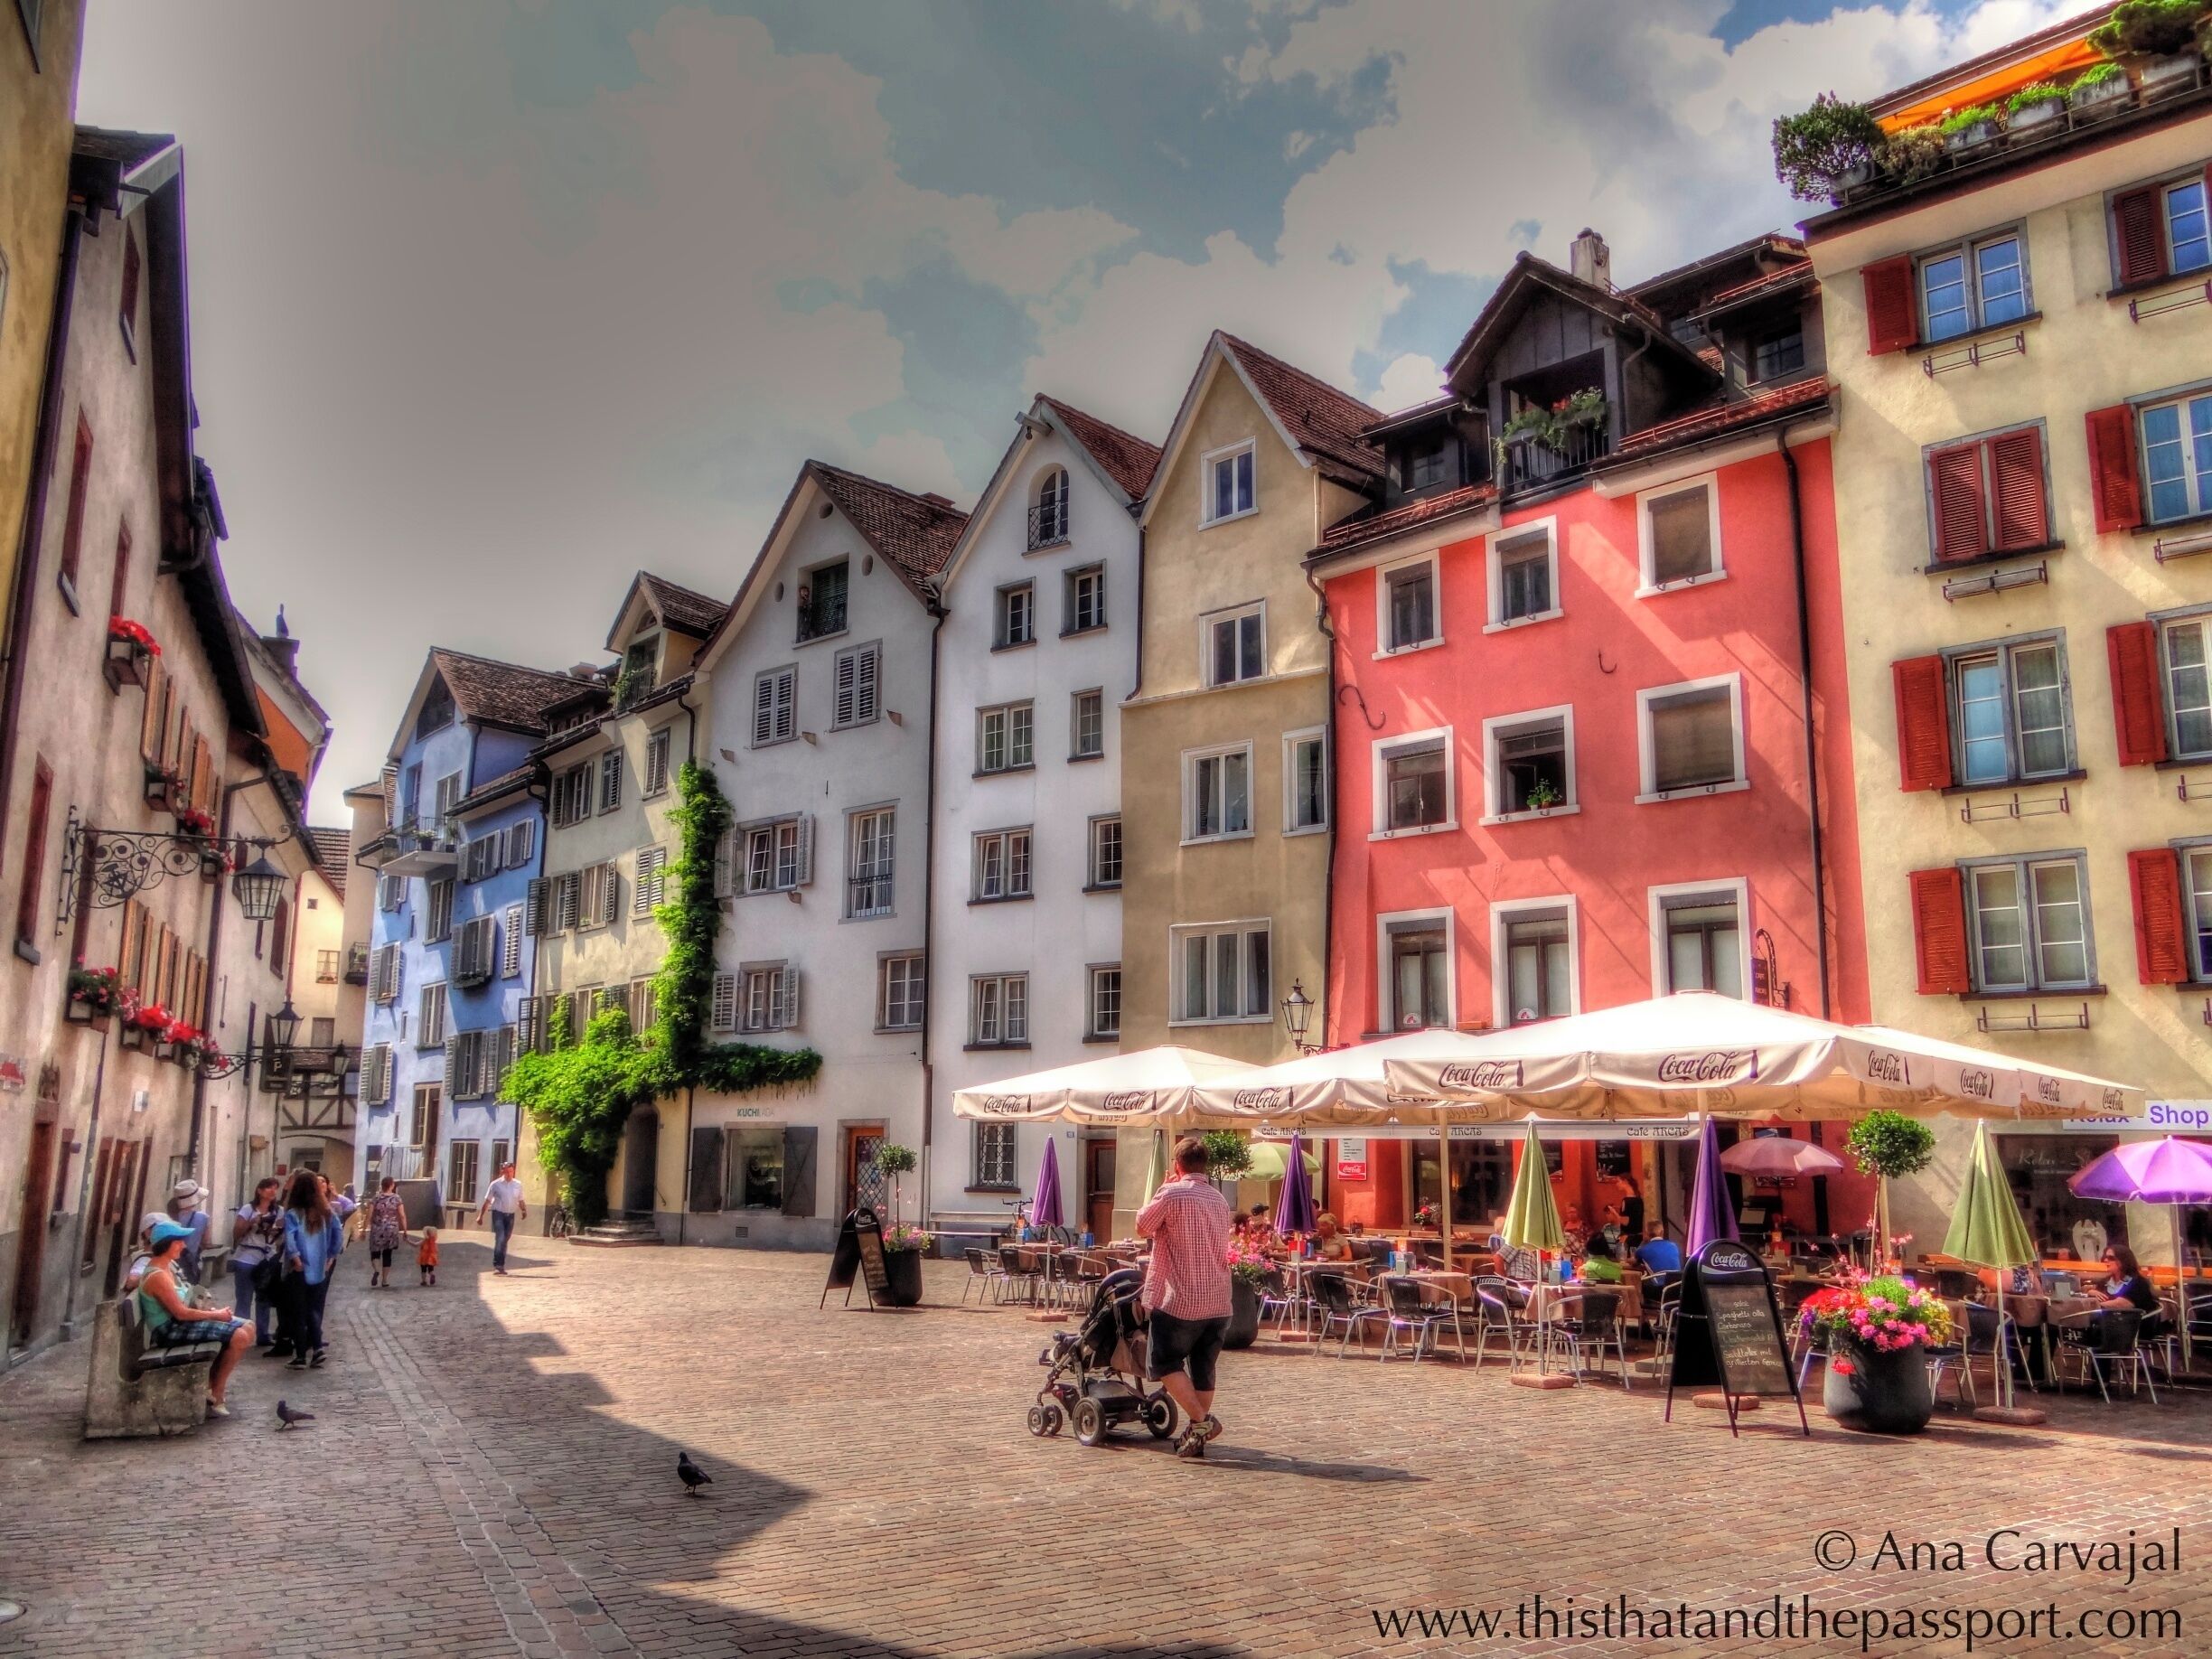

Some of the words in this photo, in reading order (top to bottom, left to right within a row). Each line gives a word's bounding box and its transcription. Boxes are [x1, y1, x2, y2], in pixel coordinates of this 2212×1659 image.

[1439, 1061, 1507, 1088] Coca-Cola
[1658, 1052, 1737, 1083] Coca-Cola
[1868, 1050, 1901, 1082] Coca-Cola
[984, 1094, 1023, 1113] Coca-Cola
[1104, 1092, 1150, 1111] Coca-Cola
[1233, 1087, 1281, 1110] Coca-Cola
[2150, 1105, 2209, 1129] Shop
[1451, 1127, 1483, 1136] ARCAS
[1626, 1127, 1649, 1137] Café
[1652, 1127, 1690, 1137] ARCAS
[1711, 1252, 1748, 1268] Coca-Cola
